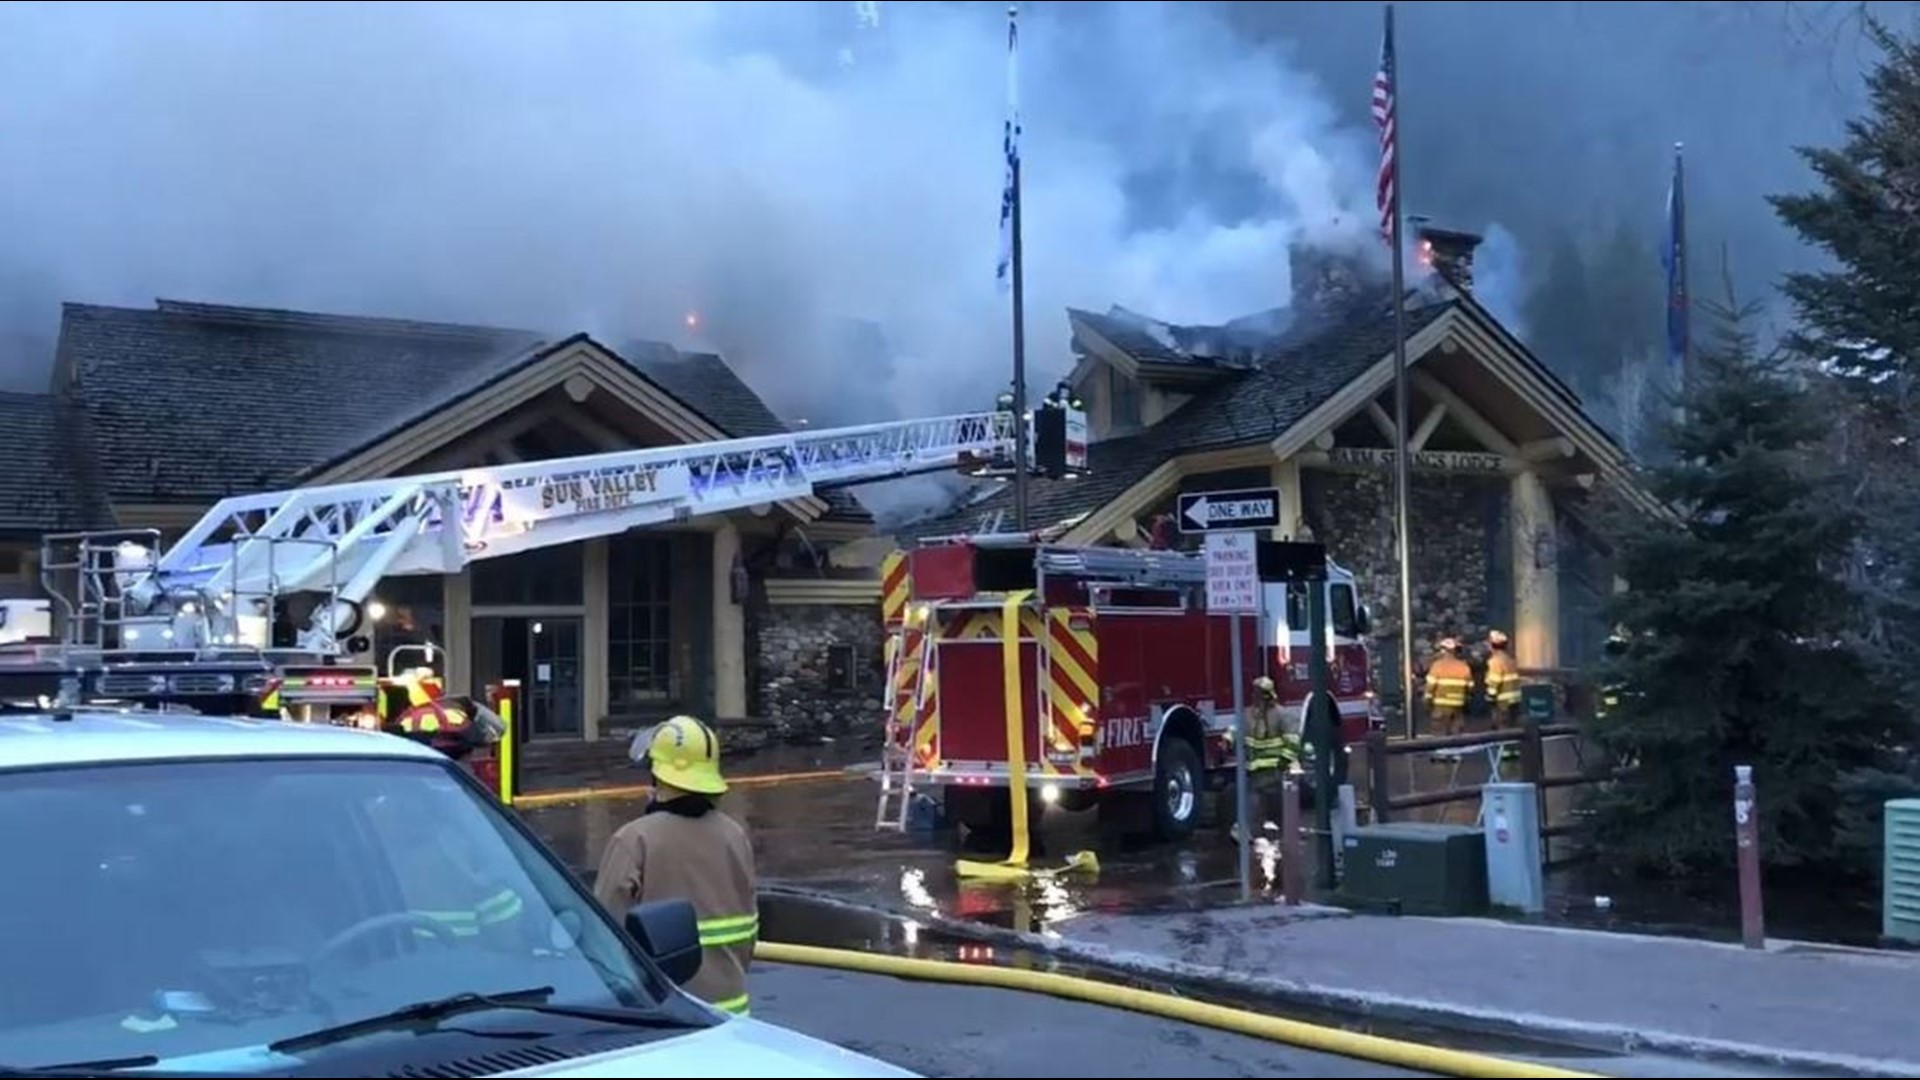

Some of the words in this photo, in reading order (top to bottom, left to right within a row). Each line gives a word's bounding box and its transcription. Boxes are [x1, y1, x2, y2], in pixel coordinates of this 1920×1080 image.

[1380, 450, 1446, 468] SPNGS
[543, 482, 582, 509] SUN
[590, 470, 657, 495] VALLEY
[576, 497, 600, 511] FIRE
[1208, 503, 1235, 518] ONE
[1241, 501, 1268, 516] WAY
[1224, 535, 1237, 547] NO
[1213, 549, 1249, 560] PARKING
[1106, 716, 1141, 748] FIRE
